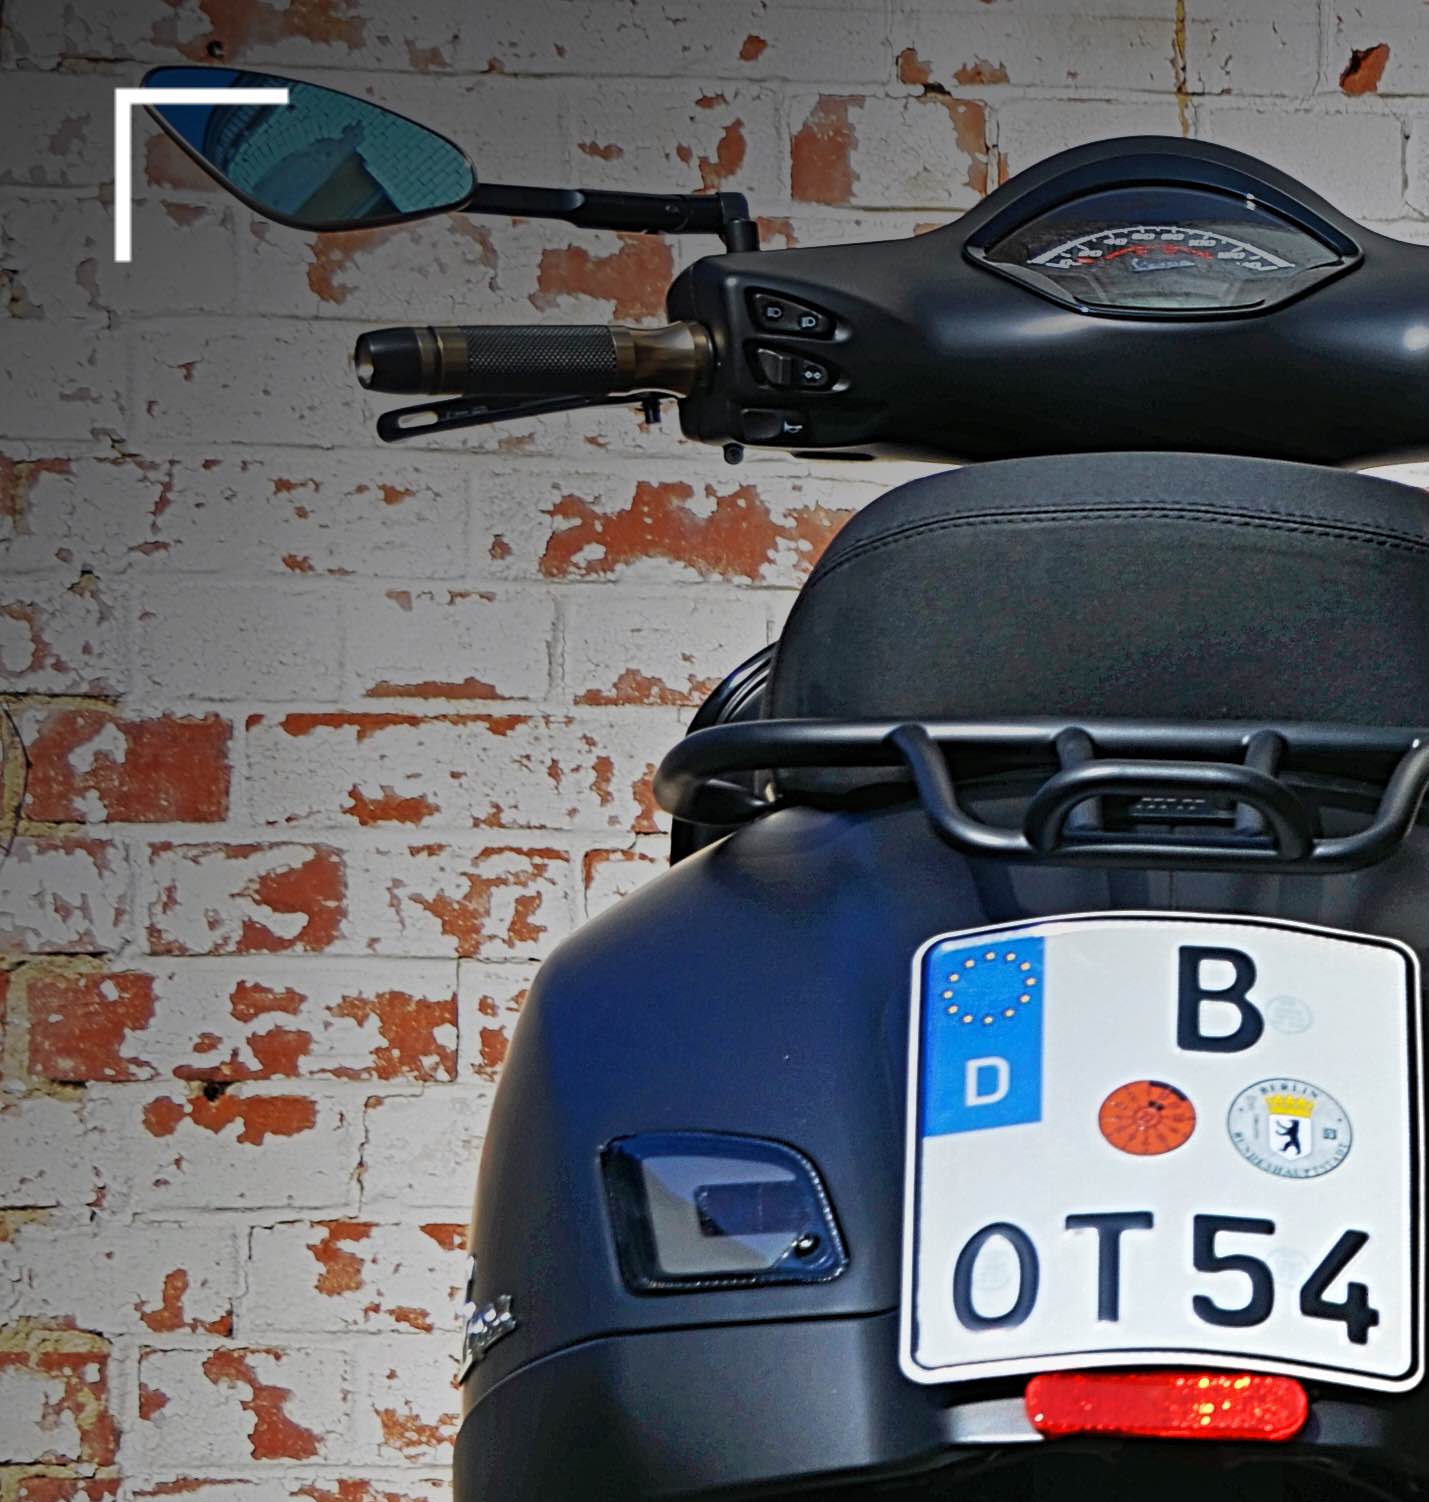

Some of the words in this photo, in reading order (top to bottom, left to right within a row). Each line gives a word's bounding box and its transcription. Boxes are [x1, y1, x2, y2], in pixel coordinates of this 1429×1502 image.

[1177, 945, 1265, 1053] B
[965, 1056, 1010, 1108] D
[1259, 1082, 1318, 1099] BERLIN
